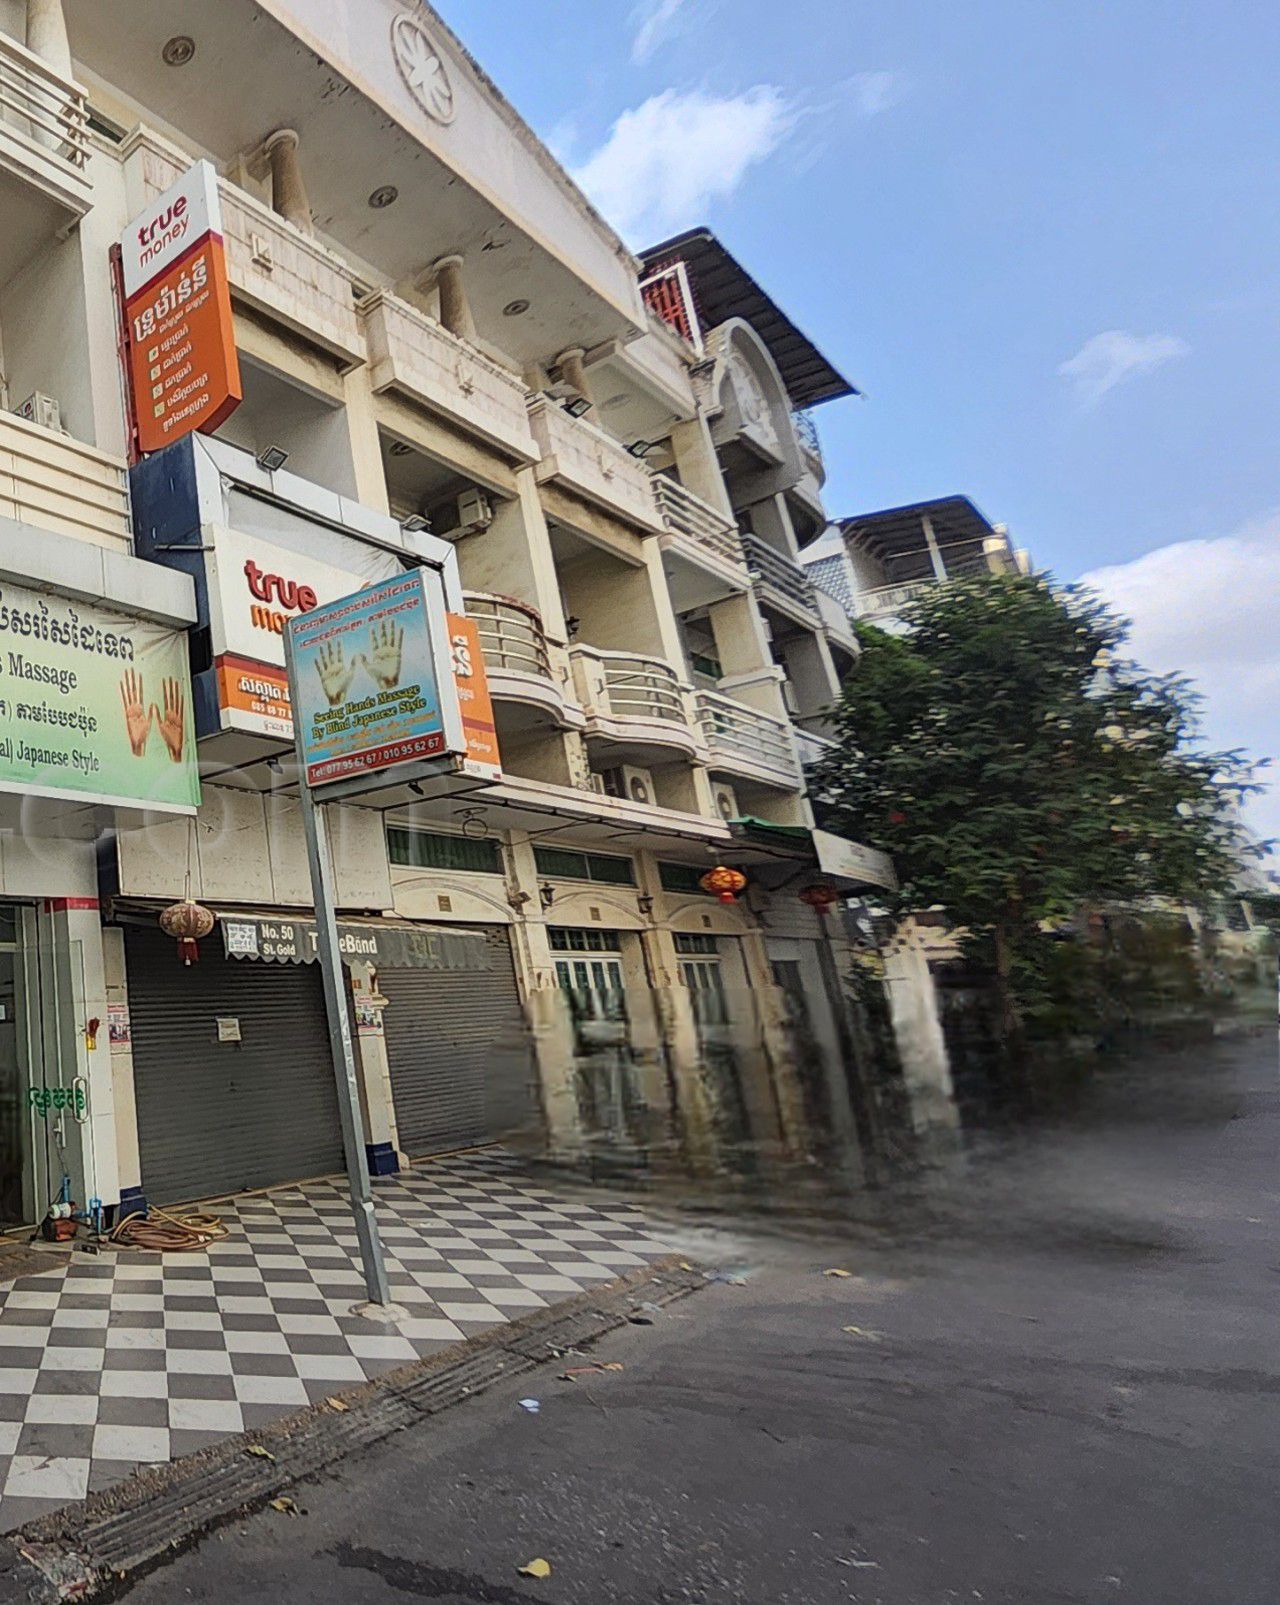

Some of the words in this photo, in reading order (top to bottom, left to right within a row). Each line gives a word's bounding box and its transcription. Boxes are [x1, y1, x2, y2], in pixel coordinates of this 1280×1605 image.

[138, 196, 187, 247] true
[139, 214, 189, 268] money
[244, 559, 317, 613] true
[8, 652, 78, 694] Massage
[312, 726, 326, 740] By
[326, 718, 350, 735] Blind
[352, 706, 397, 728] Japanese
[398, 697, 427, 714] Style
[314, 708, 345, 724] Seeing
[345, 696, 376, 715] Hands
[377, 684, 421, 704] Massage
[16, 740, 69, 768] Japanese
[71, 749, 100, 775] Style
[366, 754, 377, 764] 67
[383, 748, 400, 760] 010
[402, 744, 414, 756] 95
[414, 741, 427, 752] 62
[428, 737, 440, 749] 67
[261, 923, 280, 939] No.
[281, 925, 294, 941] 50
[276, 943, 296, 956] Gold
